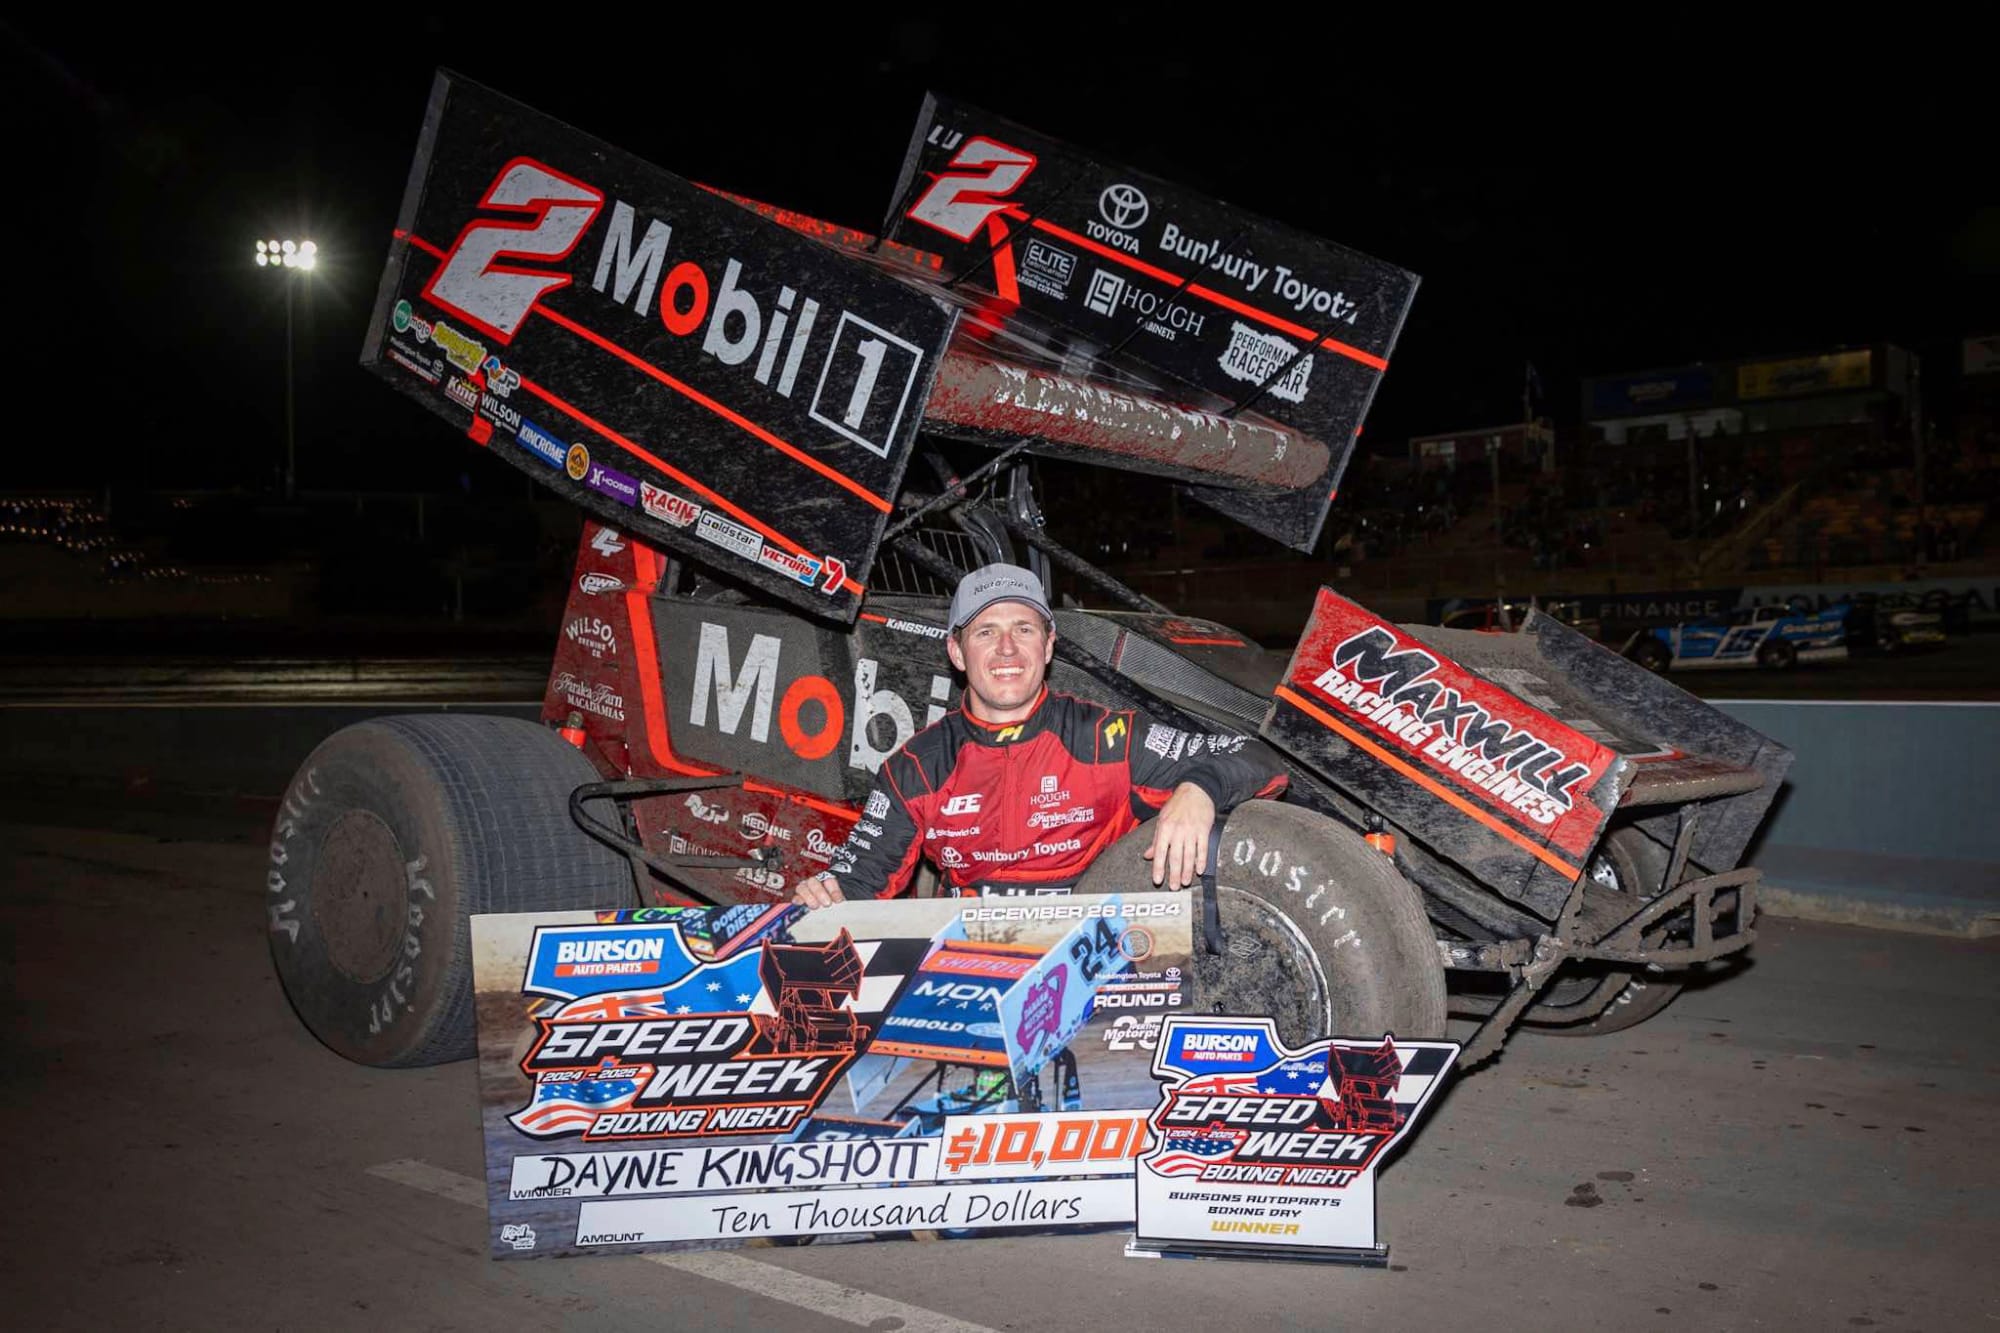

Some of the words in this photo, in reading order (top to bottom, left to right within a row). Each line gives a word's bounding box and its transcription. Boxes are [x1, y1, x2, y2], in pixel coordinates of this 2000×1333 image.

[907, 136, 1037, 242] 2
[421, 156, 604, 346] 2
[1086, 220, 1140, 255] TOYOTA
[1028, 245, 1070, 274] ELITE
[591, 199, 820, 399] Mobil
[843, 339, 889, 430] 1
[1227, 346, 1304, 395] RACEGAR
[482, 393, 521, 429] WILSON
[519, 424, 566, 465] KINCROME
[701, 513, 755, 545] Goldstar
[763, 547, 814, 576] VICTORY
[1600, 599, 1720, 618] FINANCE
[566, 617, 617, 655] WILSON
[886, 618, 949, 640] KINGSHOT
[1333, 625, 1590, 811] MAXWILL
[1312, 667, 1433, 747] RACING
[1421, 739, 1565, 824] ENGINES
[1031, 790, 1071, 805] HOUGH
[972, 848, 1029, 862] Bunbury
[1033, 839, 1081, 855] Toyota
[962, 906, 1083, 922] DECEMBER
[1087, 904, 1117, 918] 26
[1121, 903, 1181, 917] 2024
[556, 938, 664, 963] BURSON
[572, 963, 604, 976] AUTO
[605, 962, 642, 975] PARTS
[1093, 995, 1165, 1008] ROUND
[1168, 993, 1182, 1005] 6
[536, 1018, 749, 1059] SPEED
[1183, 1034, 1258, 1051] BURSON
[1192, 1052, 1215, 1060] AUTO
[1215, 1052, 1243, 1061] PARTS
[543, 1069, 583, 1082] 2024
[597, 1067, 642, 1081] 2025
[640, 1058, 827, 1099] WEEK
[591, 1108, 705, 1136] BOXING
[708, 1105, 806, 1130] NIGHT
[1166, 1096, 1318, 1124] SPEED
[1237, 1131, 1377, 1160] WEEK
[543, 1150, 678, 1196] DAYNE
[700, 1138, 929, 1188] KINGSHOTT
[1202, 1164, 1281, 1183] BOXING
[1284, 1168, 1357, 1185] NIGHT
[513, 1187, 572, 1198] WINNER
[1169, 1192, 1242, 1204] BURSONS
[1246, 1194, 1342, 1207] AUTOPARTS
[712, 1206, 770, 1236] Ten
[789, 1193, 948, 1231] Thousand
[965, 1194, 1081, 1223] Dollars
[1208, 1206, 1264, 1217] BOXING
[1269, 1207, 1302, 1218] DAY
[580, 1232, 644, 1244] AMOUNT
[1211, 1220, 1300, 1235] WINNER
